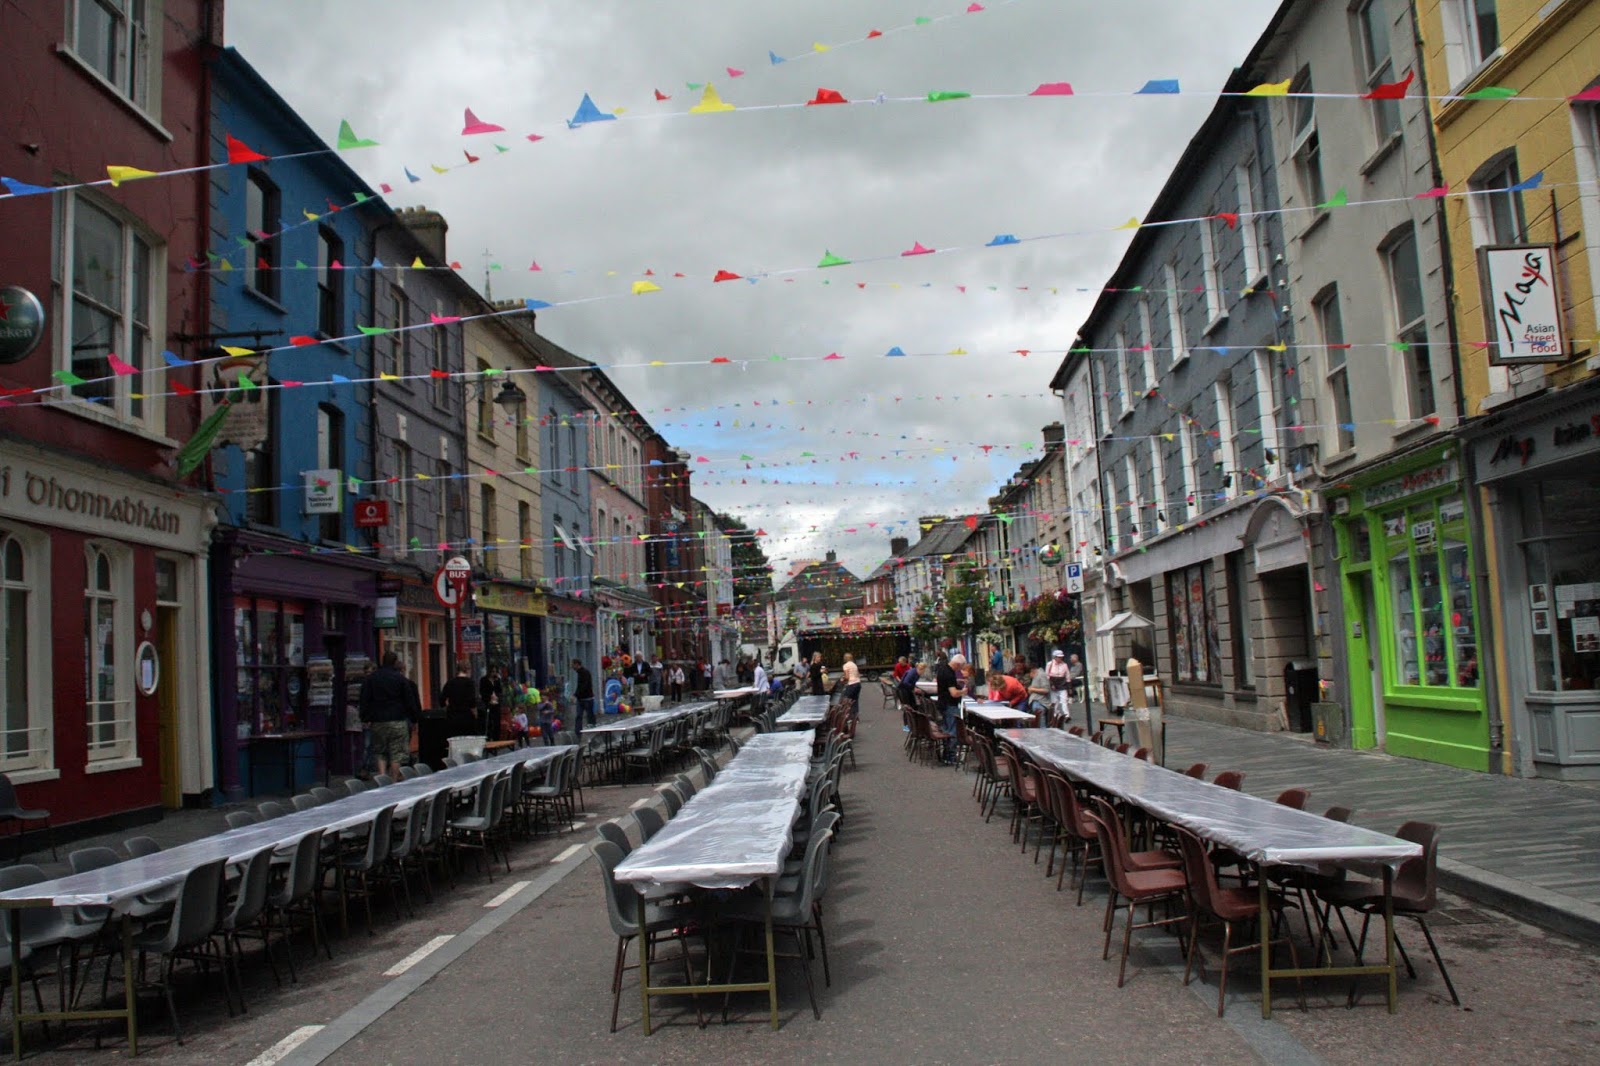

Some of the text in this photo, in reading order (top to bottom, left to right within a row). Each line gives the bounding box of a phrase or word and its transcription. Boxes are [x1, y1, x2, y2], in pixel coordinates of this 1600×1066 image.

[1526, 324, 1555, 334] Asian
[1524, 334, 1556, 343] Street
[1531, 343, 1557, 354] Food
[449, 570, 466, 579] BUS
[1070, 566, 1078, 577] P
